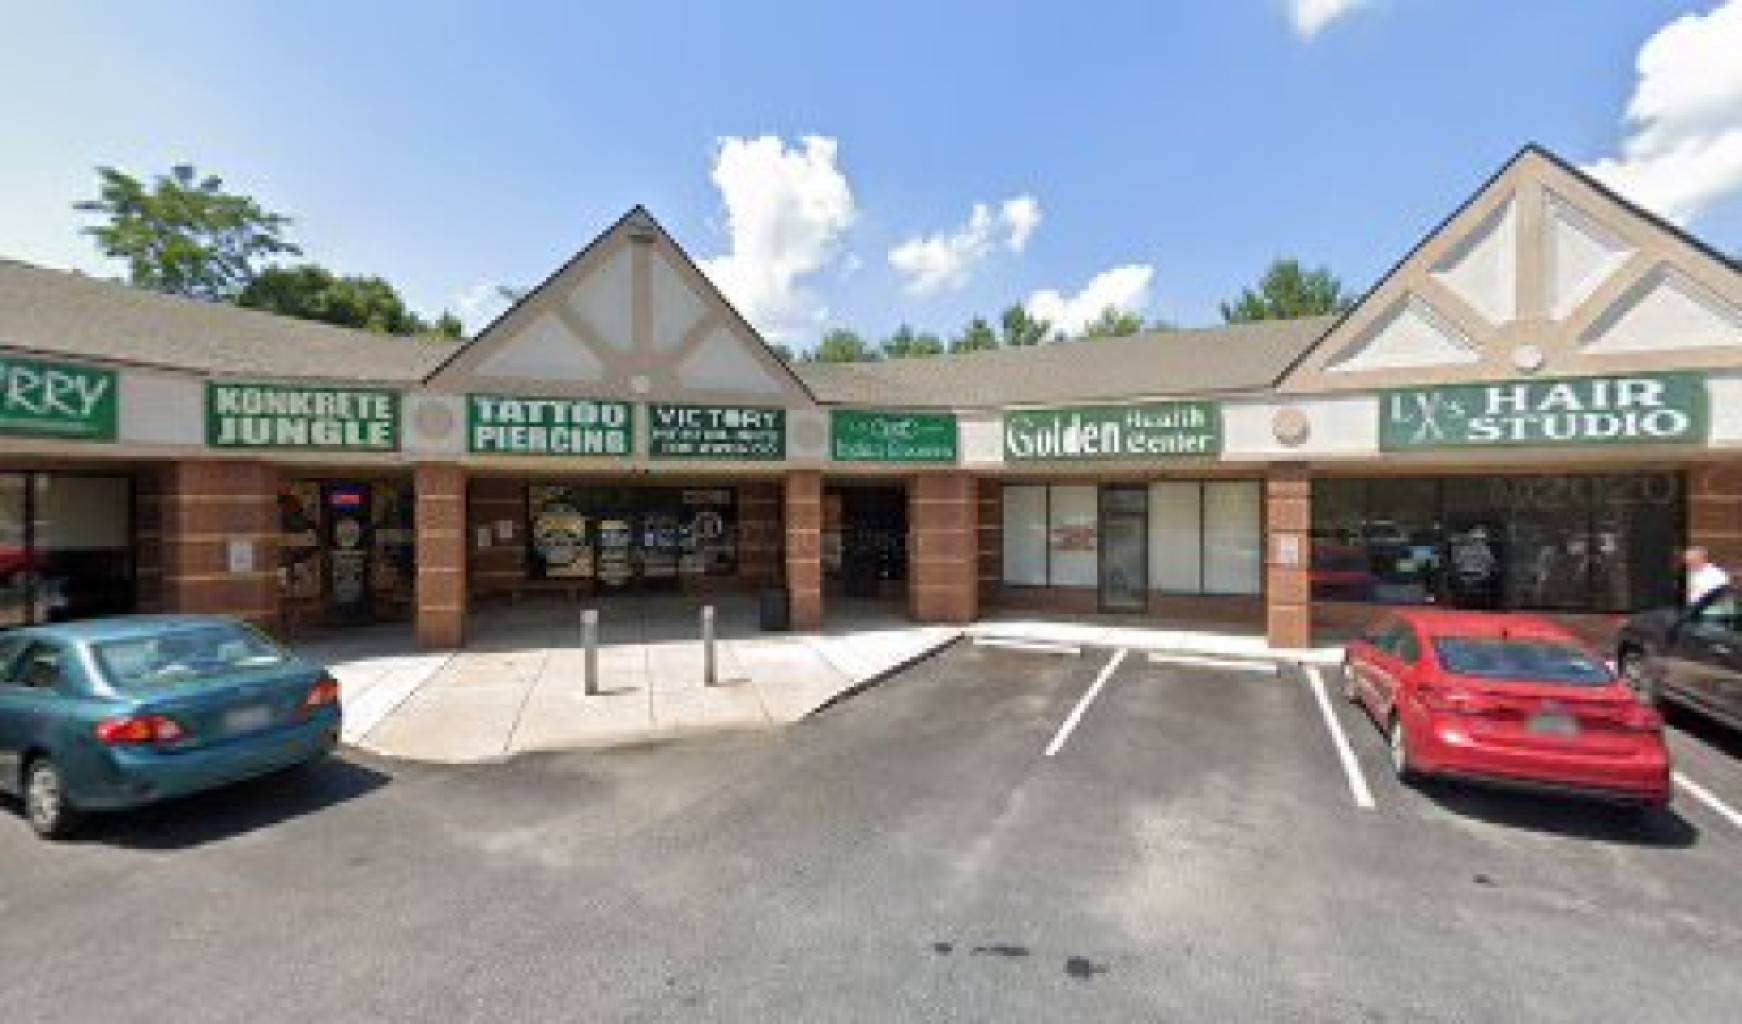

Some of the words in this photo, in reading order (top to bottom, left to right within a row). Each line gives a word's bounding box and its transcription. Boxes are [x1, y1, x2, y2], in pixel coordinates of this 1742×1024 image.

[217, 387, 394, 419] KONKRETE
[1485, 378, 1666, 414] HAIR
[475, 398, 624, 427] TATTOO
[656, 409, 778, 428] VICTORY
[1467, 409, 1690, 441] STUDIO
[217, 417, 394, 445] JUNGLE
[477, 426, 624, 453] PIERCING
[1006, 412, 1120, 457] Golden
